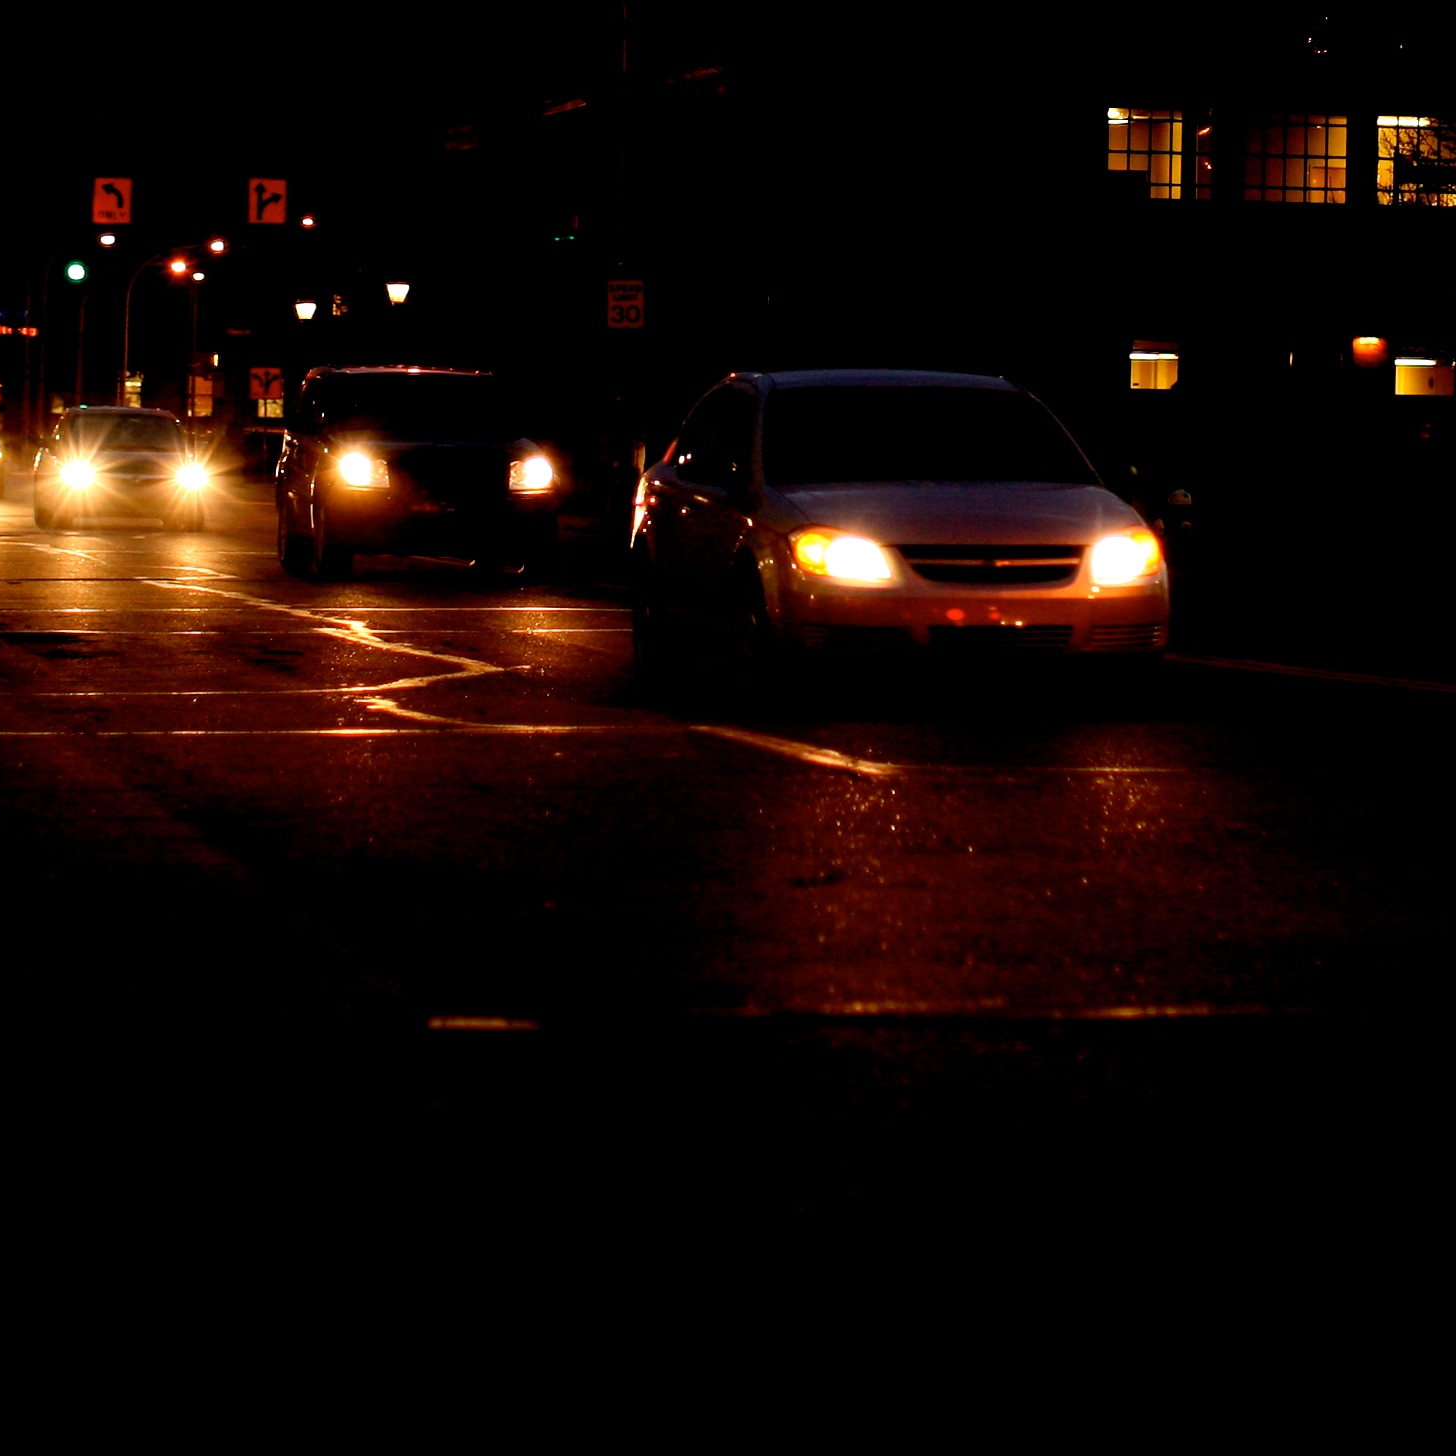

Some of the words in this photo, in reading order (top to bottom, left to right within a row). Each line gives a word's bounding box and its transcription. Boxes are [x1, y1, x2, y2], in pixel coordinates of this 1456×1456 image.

[97, 210, 127, 221] ONLY
[609, 284, 643, 293] SPEED
[612, 293, 638, 301] LIMIT
[610, 304, 641, 323] 30
